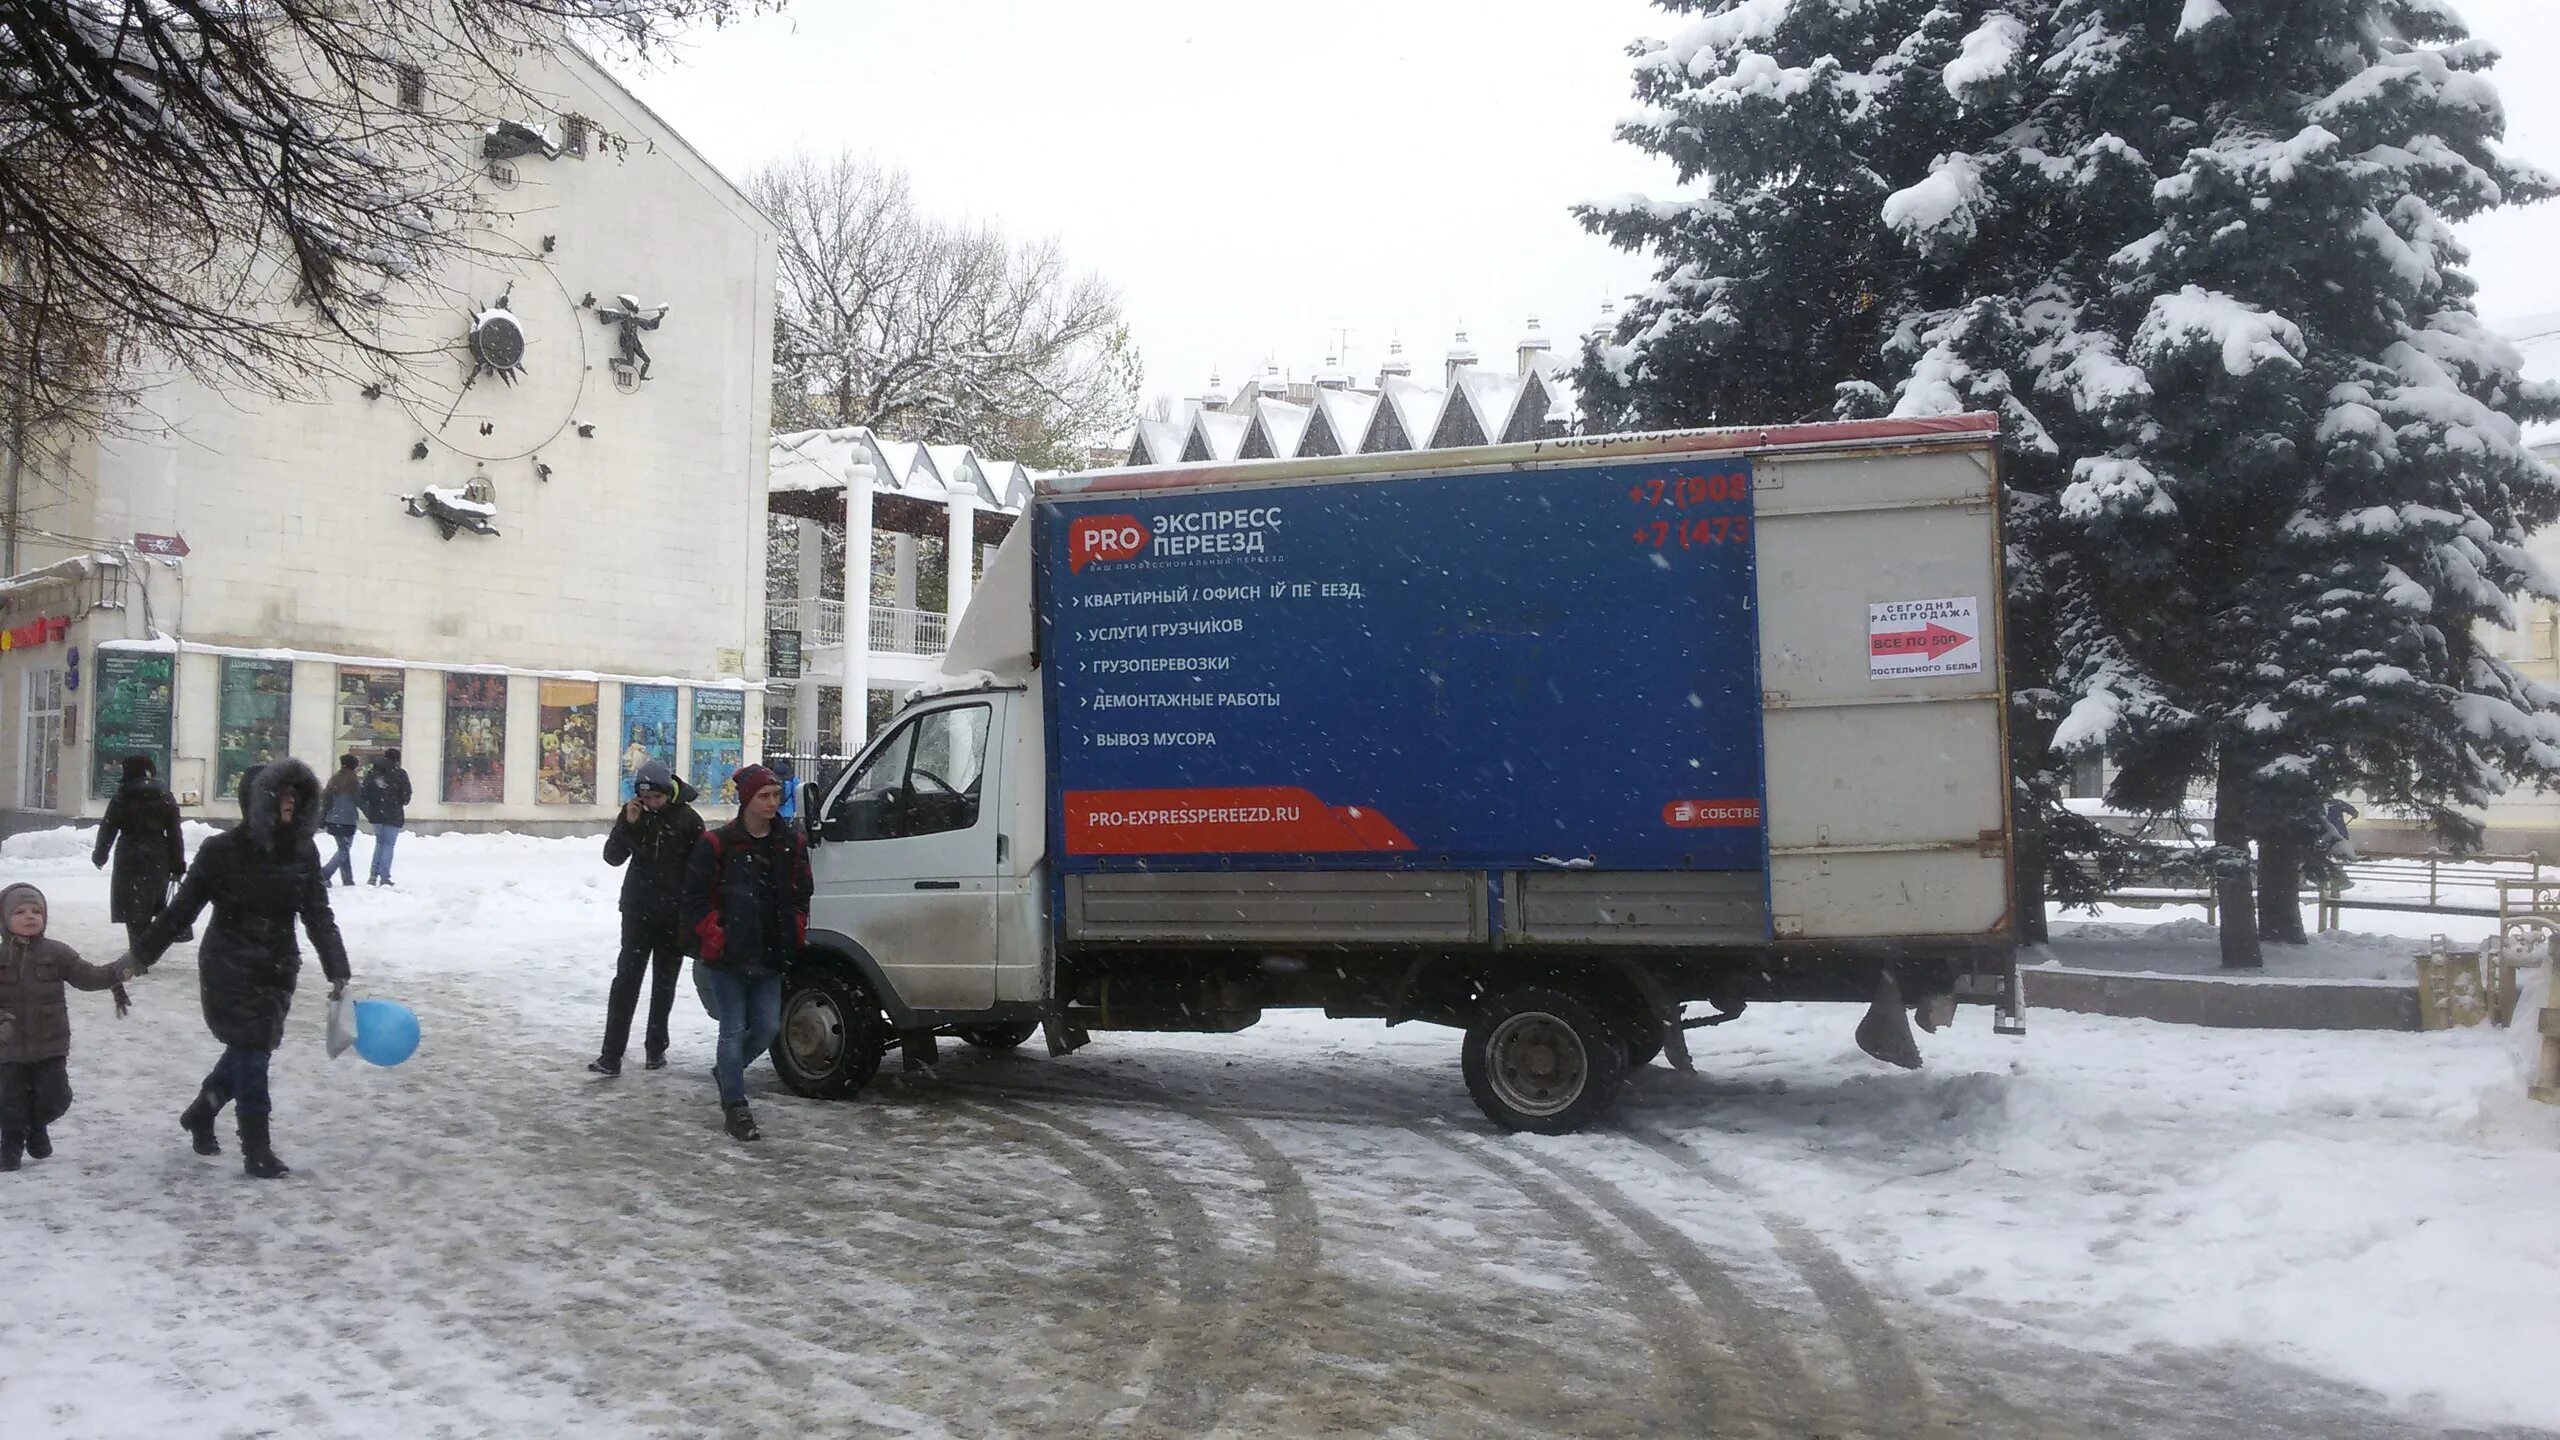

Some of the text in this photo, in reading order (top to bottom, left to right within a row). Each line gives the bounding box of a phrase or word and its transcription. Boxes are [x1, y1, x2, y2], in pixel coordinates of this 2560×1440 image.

[1152, 506, 1283, 534] ЭКСПРЕСС
[1083, 527, 1141, 552] PRO
[1153, 531, 1265, 557] ПЕРЕЕЗД
[1083, 586, 1189, 608] КВАРТИРНЫЙ
[1291, 582, 1362, 600] ПЕЕЕЗД
[1872, 609, 1970, 622] РАСПРОДАЖА
[1887, 602, 1953, 613] СЕГОДНЯ
[1088, 618, 1244, 642] УСЛУГИ ГРУЗЧИКОВ
[1873, 638, 1903, 649] ВСЕ
[1906, 636, 1928, 648] ПО
[1093, 656, 1231, 673] ГРУЗОПЕРЕВОЗКИ
[1871, 663, 1977, 675] ПОСТЕЛЬНОГО БЕЛЬЯ
[1093, 693, 1281, 711] ДЕМОНТАЖНЫЕ РАБОТЫ
[1096, 732, 1217, 746] ВЫВОЗ МУСОРА
[1088, 806, 1301, 827] PRO-EXPRESSPEREEZD.RU
[1700, 807, 1761, 819] СОБСТВЕ
